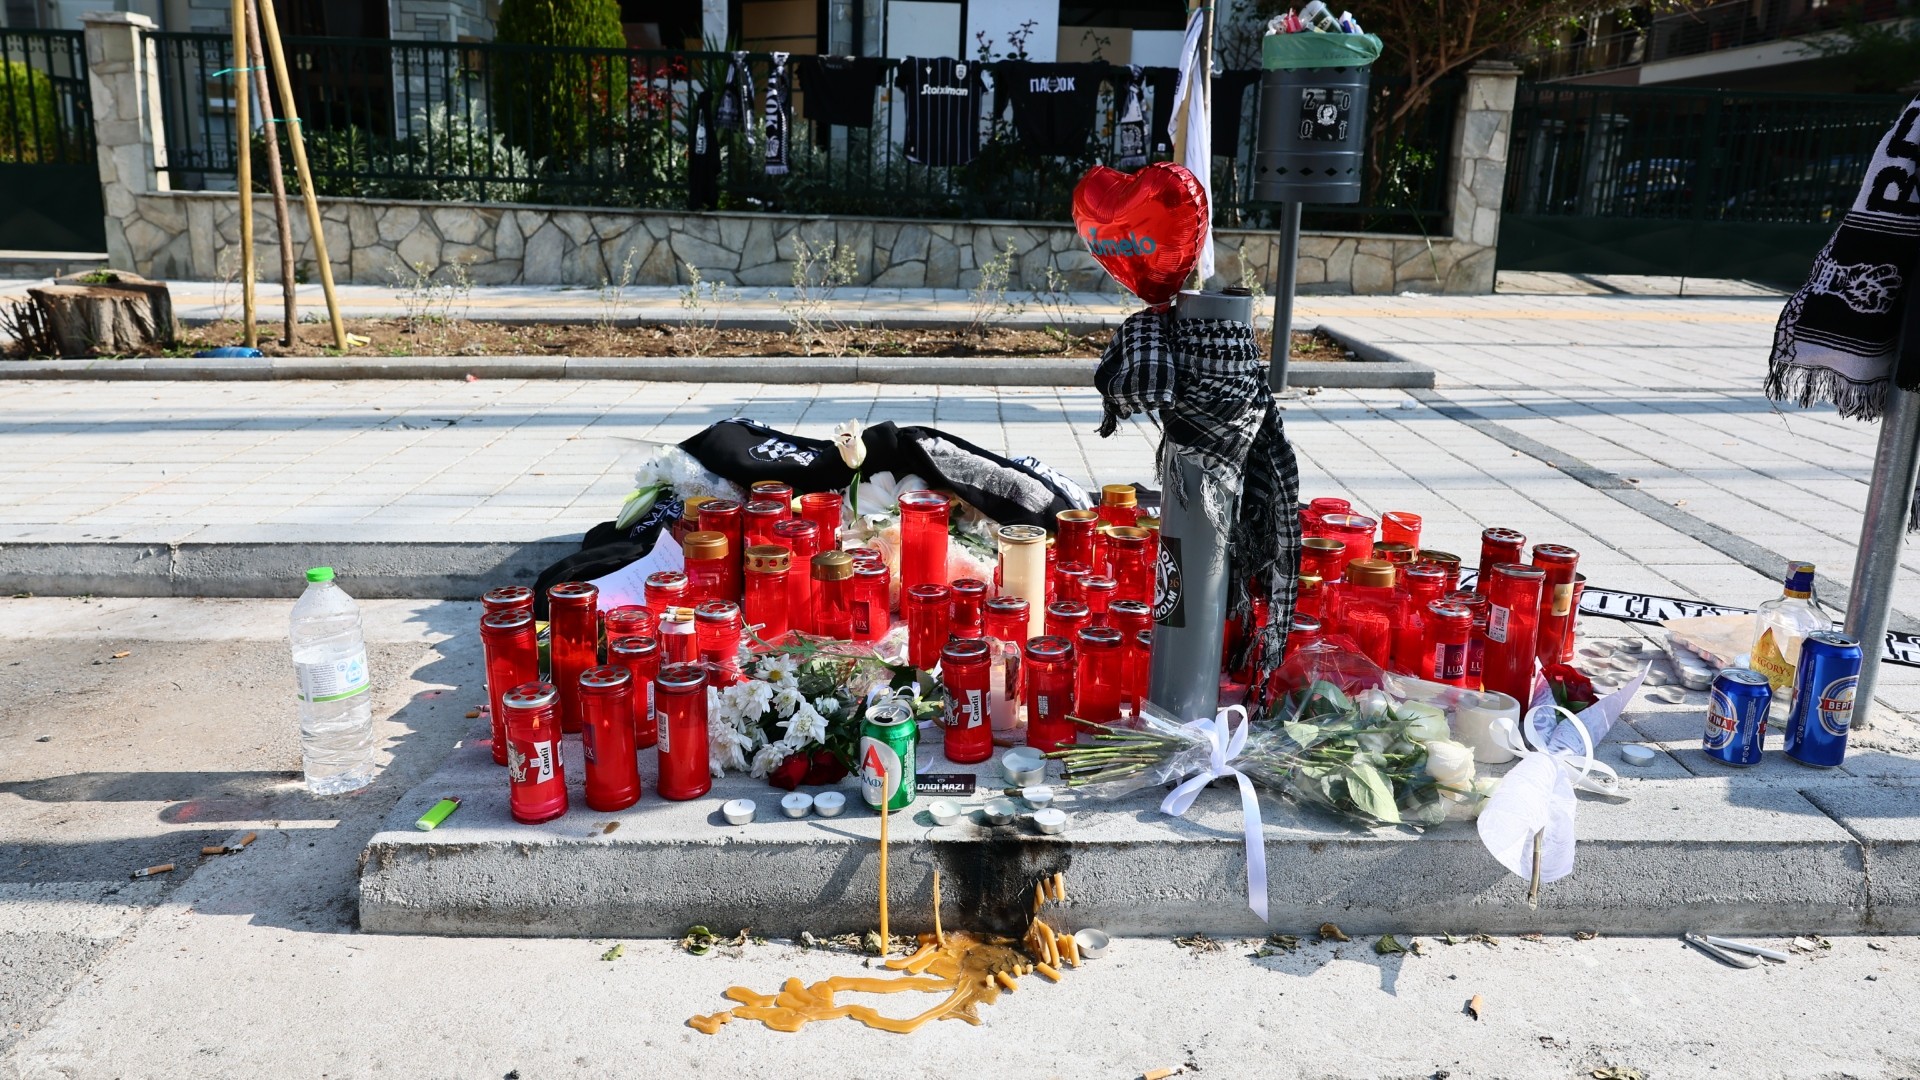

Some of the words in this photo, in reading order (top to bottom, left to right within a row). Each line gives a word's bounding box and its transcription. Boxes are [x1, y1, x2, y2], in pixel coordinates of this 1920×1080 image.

[921, 84, 969, 97] Stoiximan
[1446, 664, 1464, 673] LUX
[972, 695, 980, 722] Candil
[542, 746, 551, 776] Candil
